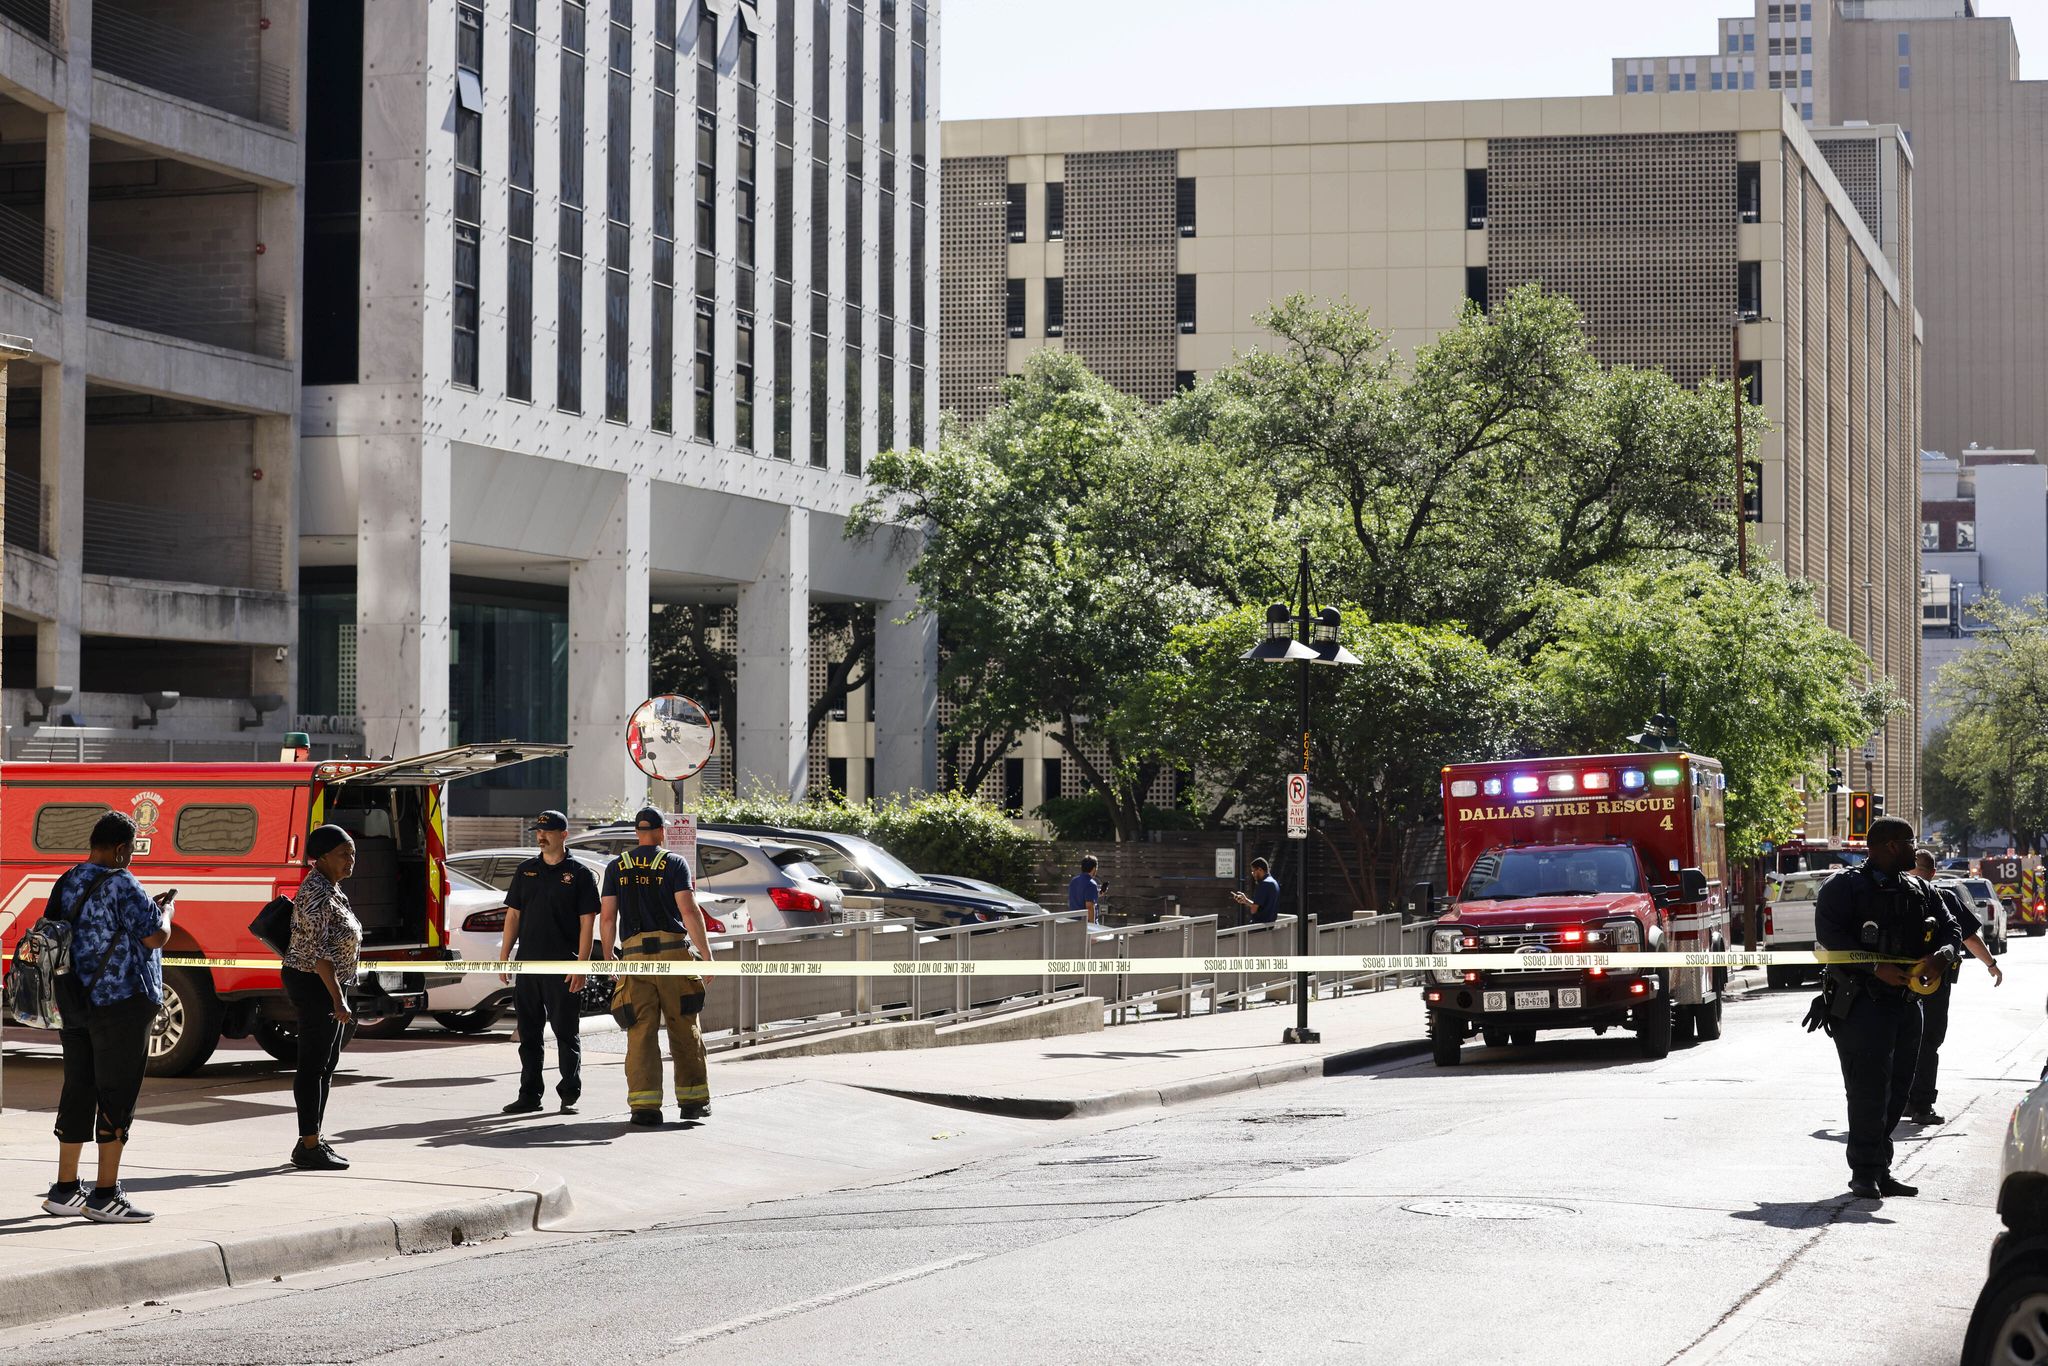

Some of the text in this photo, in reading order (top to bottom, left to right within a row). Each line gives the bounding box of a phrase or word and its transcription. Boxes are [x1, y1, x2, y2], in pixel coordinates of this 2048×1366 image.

[130, 791, 165, 806] BATTALION
[1290, 808, 1304, 817] ANY
[1459, 797, 1675, 822] DALLAS FIRE RESCUE
[1289, 817, 1305, 826] TIME
[1659, 815, 1674, 831] 4
[617, 856, 667, 871] DLLS
[1996, 862, 2017, 879] 18
[619, 875, 664, 886] FIE DET
[364, 961, 378, 969] FIRE
[1204, 959, 1288, 970] FIRE LINE DO NOT CROSS
[1363, 956, 1447, 968] FIRE LINE DO NOT CROSS
[1523, 955, 1609, 966] FIRE LINE DO NOT CROSS
[1686, 954, 1773, 965] FIRE LINE DO NOT CROSS
[445, 962, 523, 972] FIRE LINE DO NOT CROSS
[591, 963, 671, 973] FIRE LINE DO NOT CROSS
[741, 963, 822, 973] FIRE LINE DO NOT CROSS
[893, 962, 975, 973] FIRE LINE DO NOT CROSS
[1047, 961, 1131, 972] FIRE LINE DO NOT CROSS
